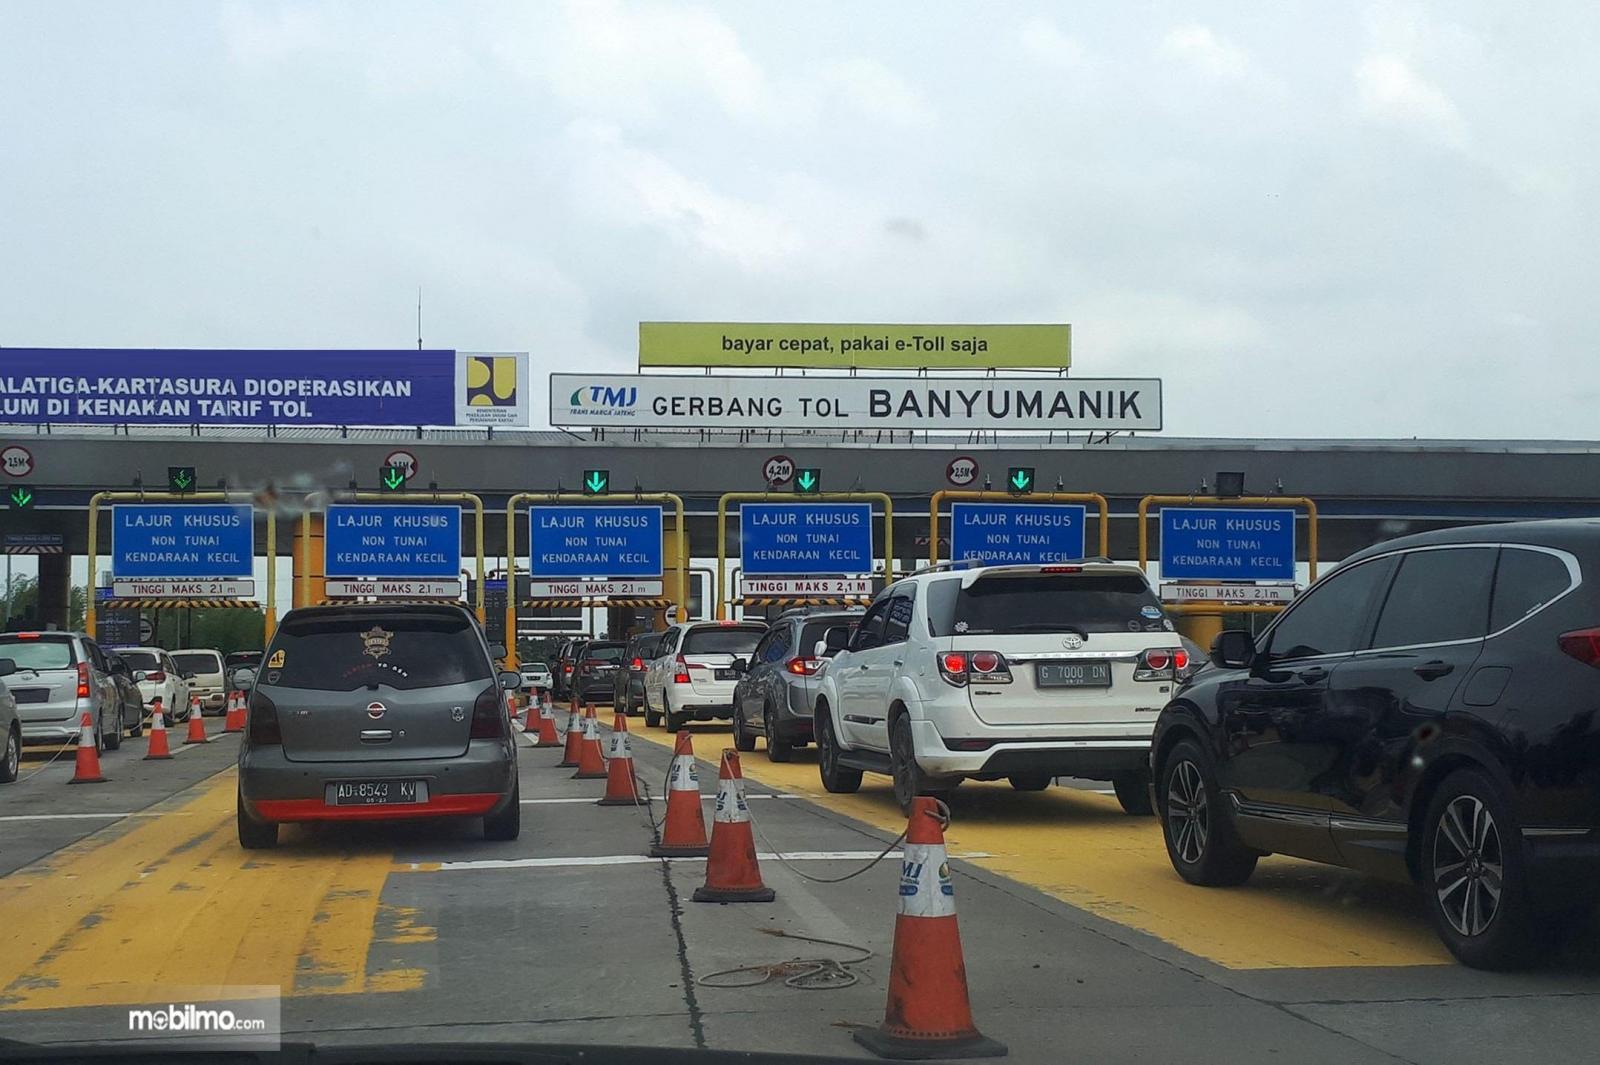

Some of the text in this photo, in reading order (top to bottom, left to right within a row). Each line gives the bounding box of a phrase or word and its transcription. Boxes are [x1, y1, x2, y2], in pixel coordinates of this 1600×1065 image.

[722, 335, 988, 355] bayar cepat, pakai e-Toll saja
[244, 379, 412, 397] DIOPERASIKAN
[590, 386, 637, 407] TMJ
[47, 399, 70, 415] DI
[78, 399, 190, 416] KENAKAN
[198, 400, 262, 417] TARIF
[269, 401, 312, 417] TOL
[653, 389, 1142, 419] GERBANG TOL BANYUMANIK
[125, 514, 240, 527] LAJUR KHUSUS
[337, 515, 448, 527] LAJUR KHUSUS
[541, 516, 648, 528] LAJUR KHUSUS
[752, 513, 860, 525] LAJUR KHUSUS
[964, 513, 1071, 526] LAJUR KHUSUS
[1173, 518, 1281, 531] LAJUR KHUSUS
[152, 536, 219, 545] NON TUNAI
[362, 536, 427, 546] NON TUNAI
[566, 537, 627, 546] NON TUNAI
[776, 534, 839, 543] NON TUNAI
[987, 534, 1050, 545] NON TUNAI
[1196, 540, 1261, 549] NON TUNAI
[125, 552, 240, 563] KENDARAAN KECIL
[337, 553, 447, 563] KENDARAAN KECIL
[542, 554, 649, 563] KENDARAAN KECIL
[753, 550, 860, 560] KENDARAAN KECIL
[963, 551, 1069, 562] KENDARAAN KECIL
[1173, 556, 1282, 567] KENDARAAN KECIL
[132, 584, 165, 594] TINGGI
[344, 584, 375, 593] TINGGI
[548, 584, 579, 594] TINGGI
[748, 582, 788, 591] TINGGI
[795, 582, 829, 591] MAKS
[1176, 587, 1208, 598] TINGGI
[1216, 588, 1245, 598] MAKS
[1041, 666, 1049, 679] G
[1058, 666, 1083, 679] 7000
[338, 783, 353, 798] AD
[360, 783, 388, 796] 8543
